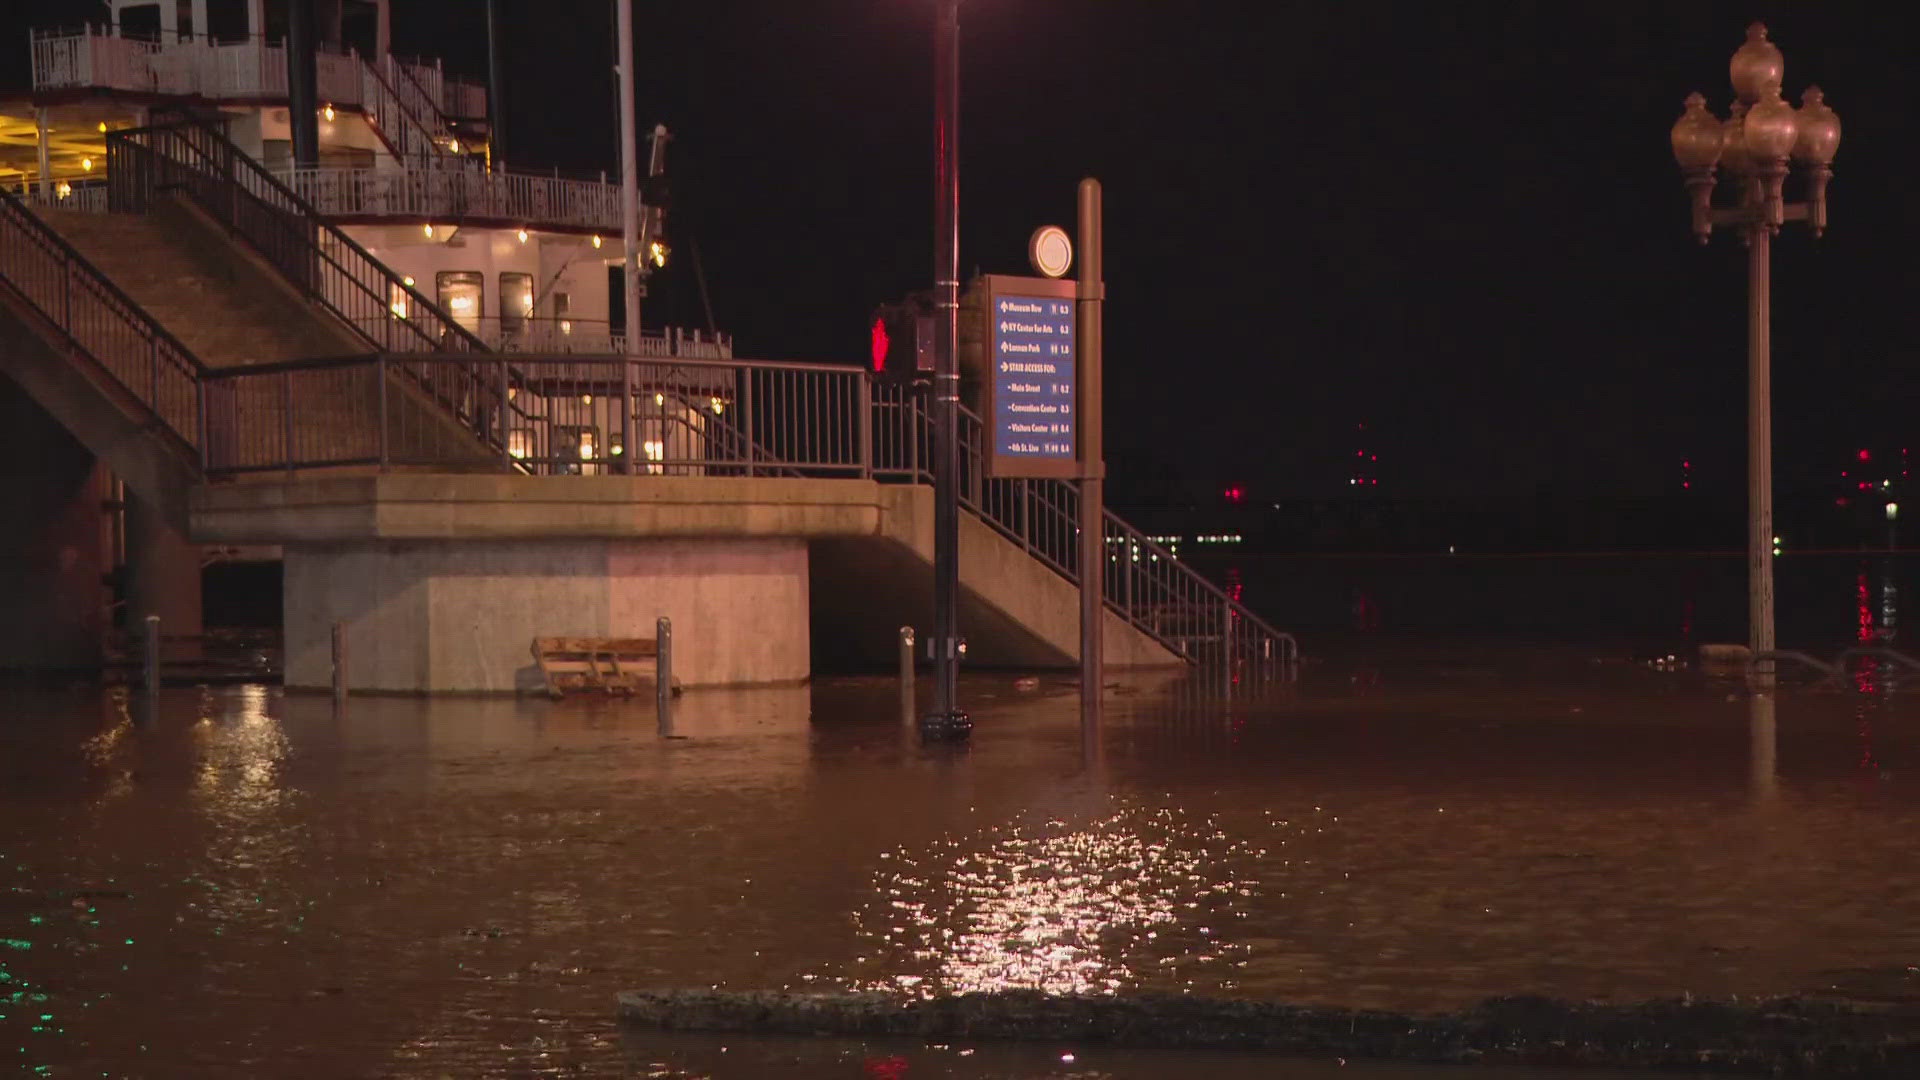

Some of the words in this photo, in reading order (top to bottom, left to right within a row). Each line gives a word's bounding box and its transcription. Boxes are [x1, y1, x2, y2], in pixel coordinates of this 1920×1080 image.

[1017, 323, 1034, 332] Center
[1028, 344, 1040, 353] Park
[1009, 362, 1024, 372] STAIR
[1024, 363, 1044, 373] ACCESS
[1012, 384, 1024, 392] Main
[1026, 384, 1040, 393] Street
[1012, 403, 1040, 412] Convention
[1040, 404, 1057, 413] Center
[1032, 424, 1048, 433] Center
